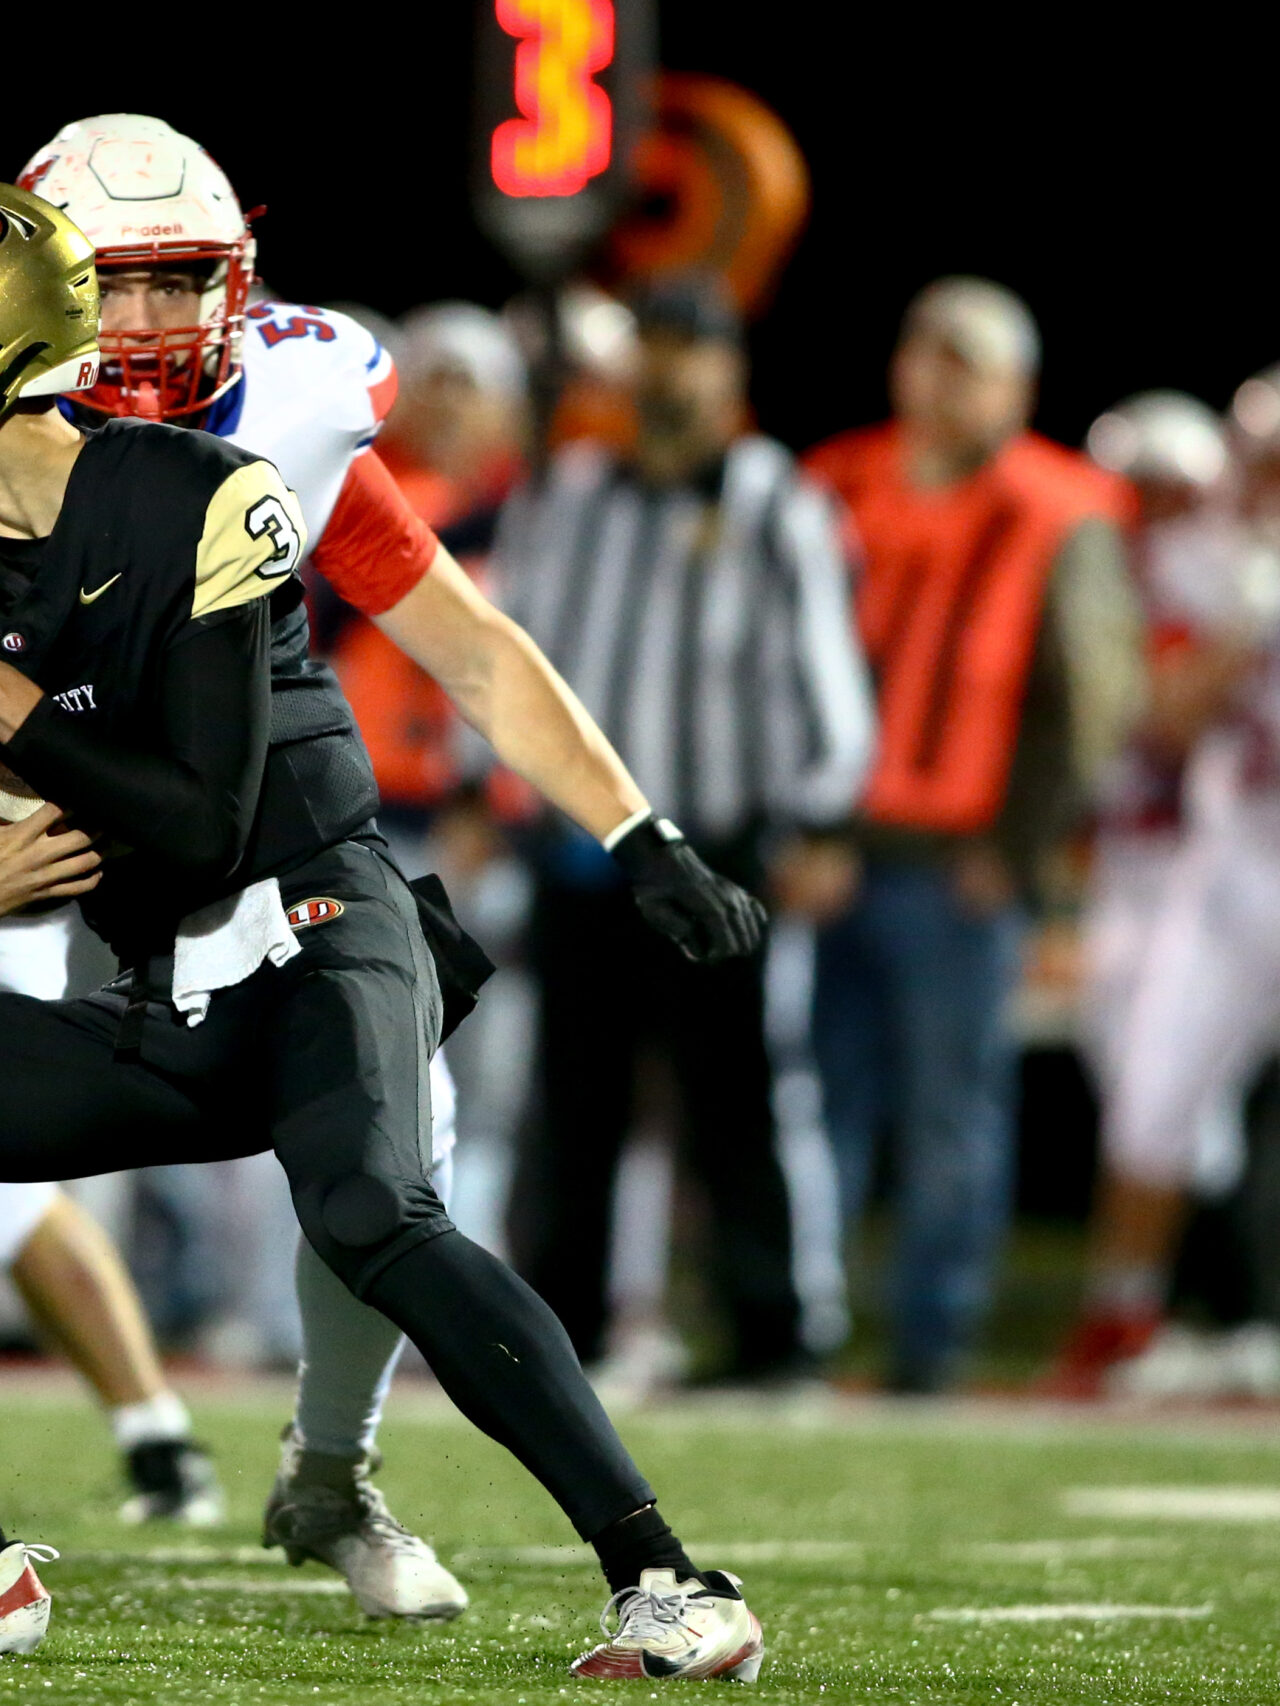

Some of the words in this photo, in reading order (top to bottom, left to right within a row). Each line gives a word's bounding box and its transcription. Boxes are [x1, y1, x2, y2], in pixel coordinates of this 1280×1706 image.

[492, 0, 616, 198] 3
[244, 493, 301, 581] 3
[52, 684, 98, 712] ITY
